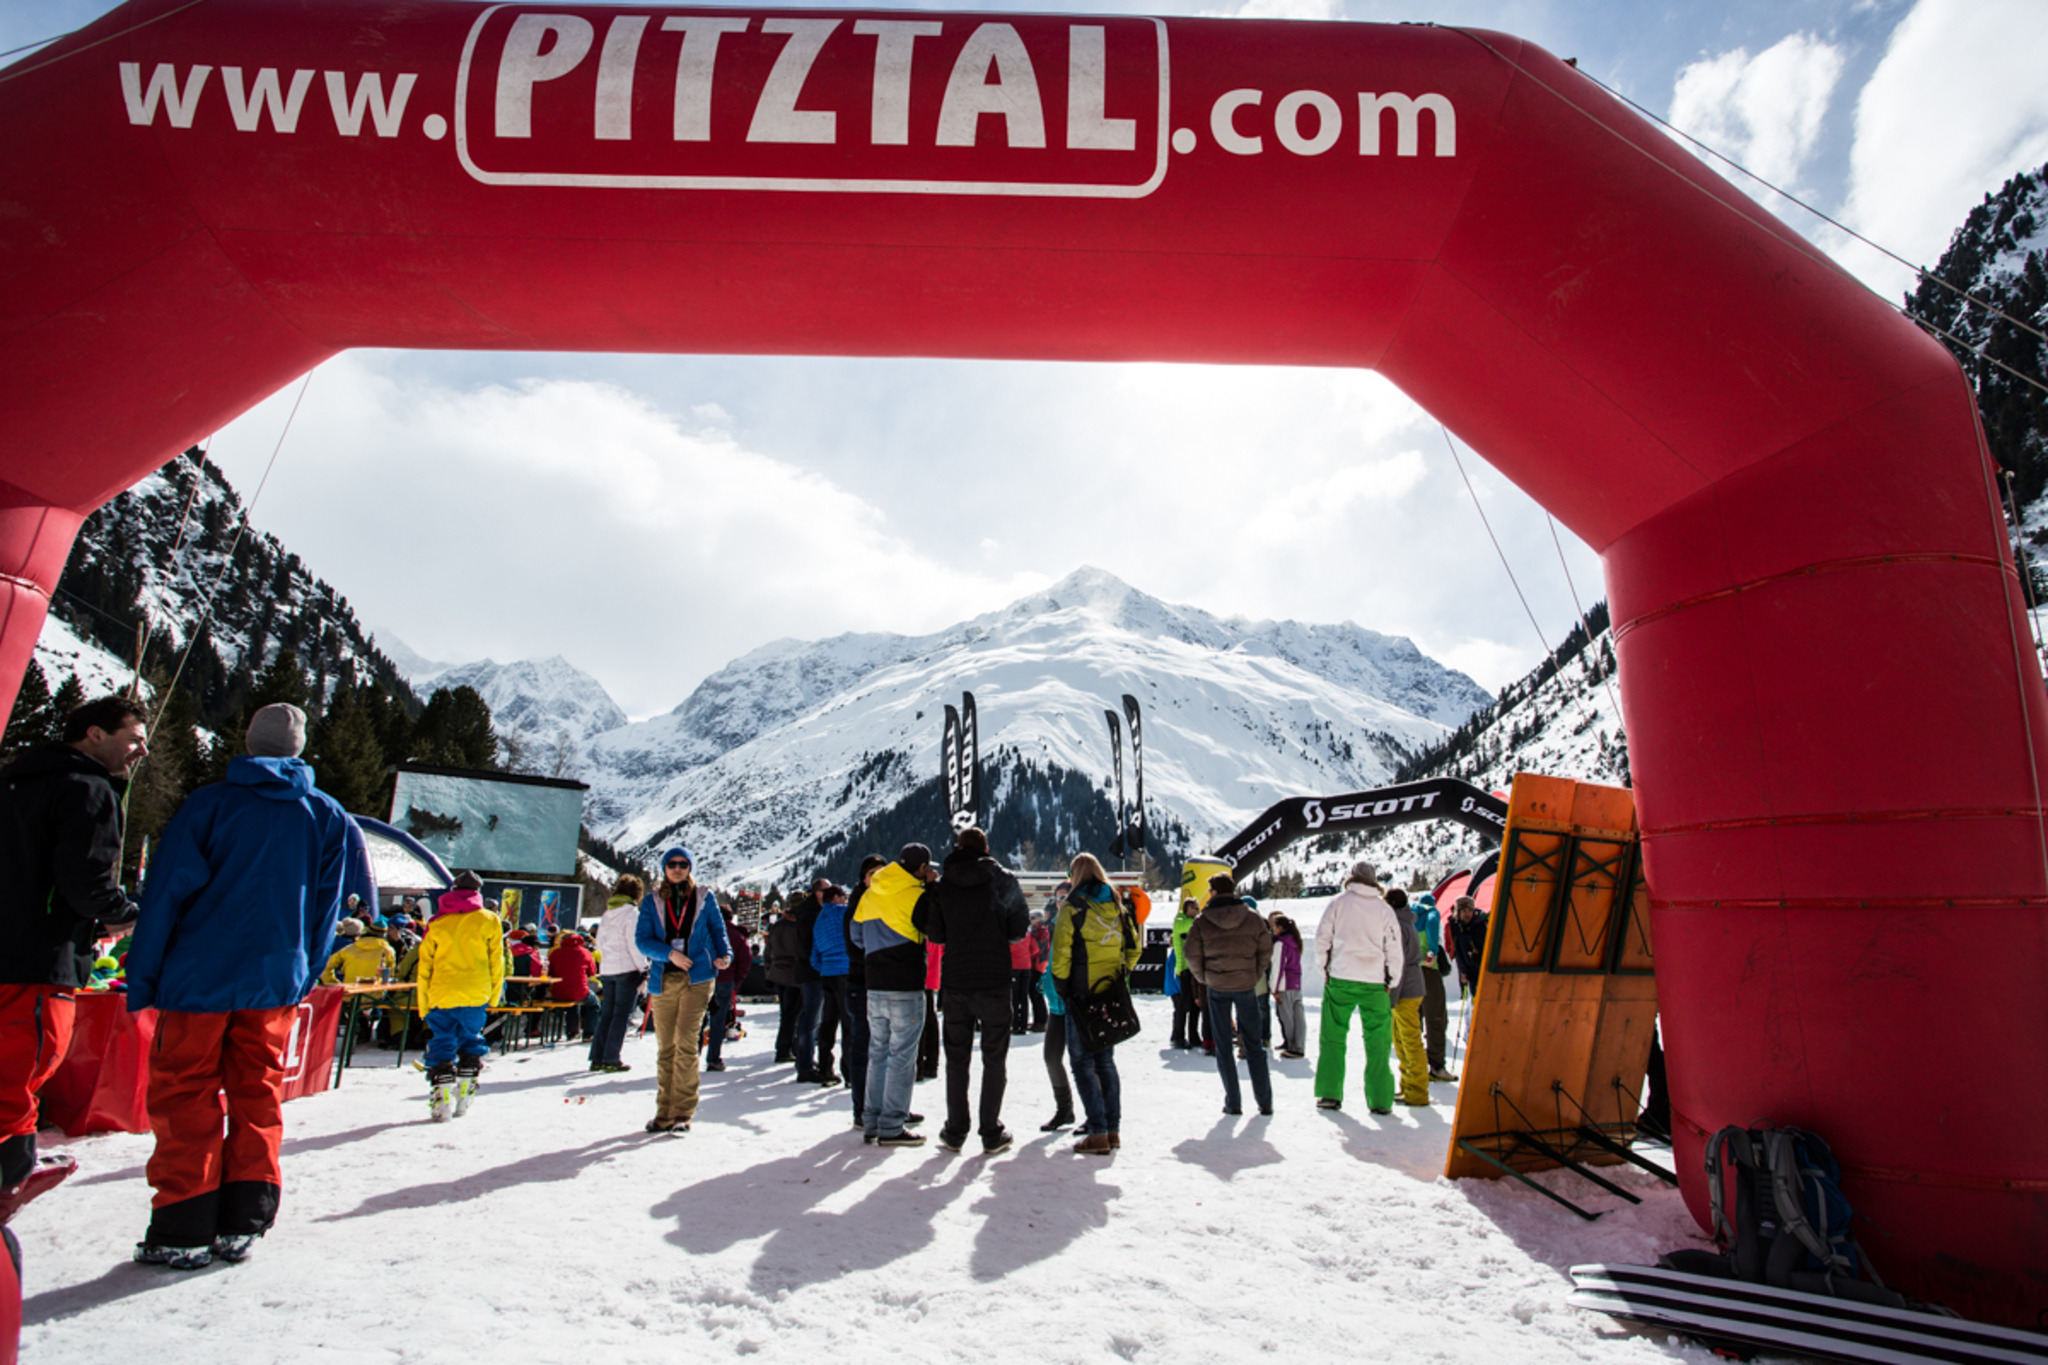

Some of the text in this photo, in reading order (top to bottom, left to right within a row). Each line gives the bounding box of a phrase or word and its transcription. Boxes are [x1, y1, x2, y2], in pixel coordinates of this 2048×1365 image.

[1327, 791, 1441, 821] SCOTT
[1473, 806, 1507, 827] SCO
[1236, 816, 1283, 861] SCOTT
[1135, 963, 1163, 971] OTT
